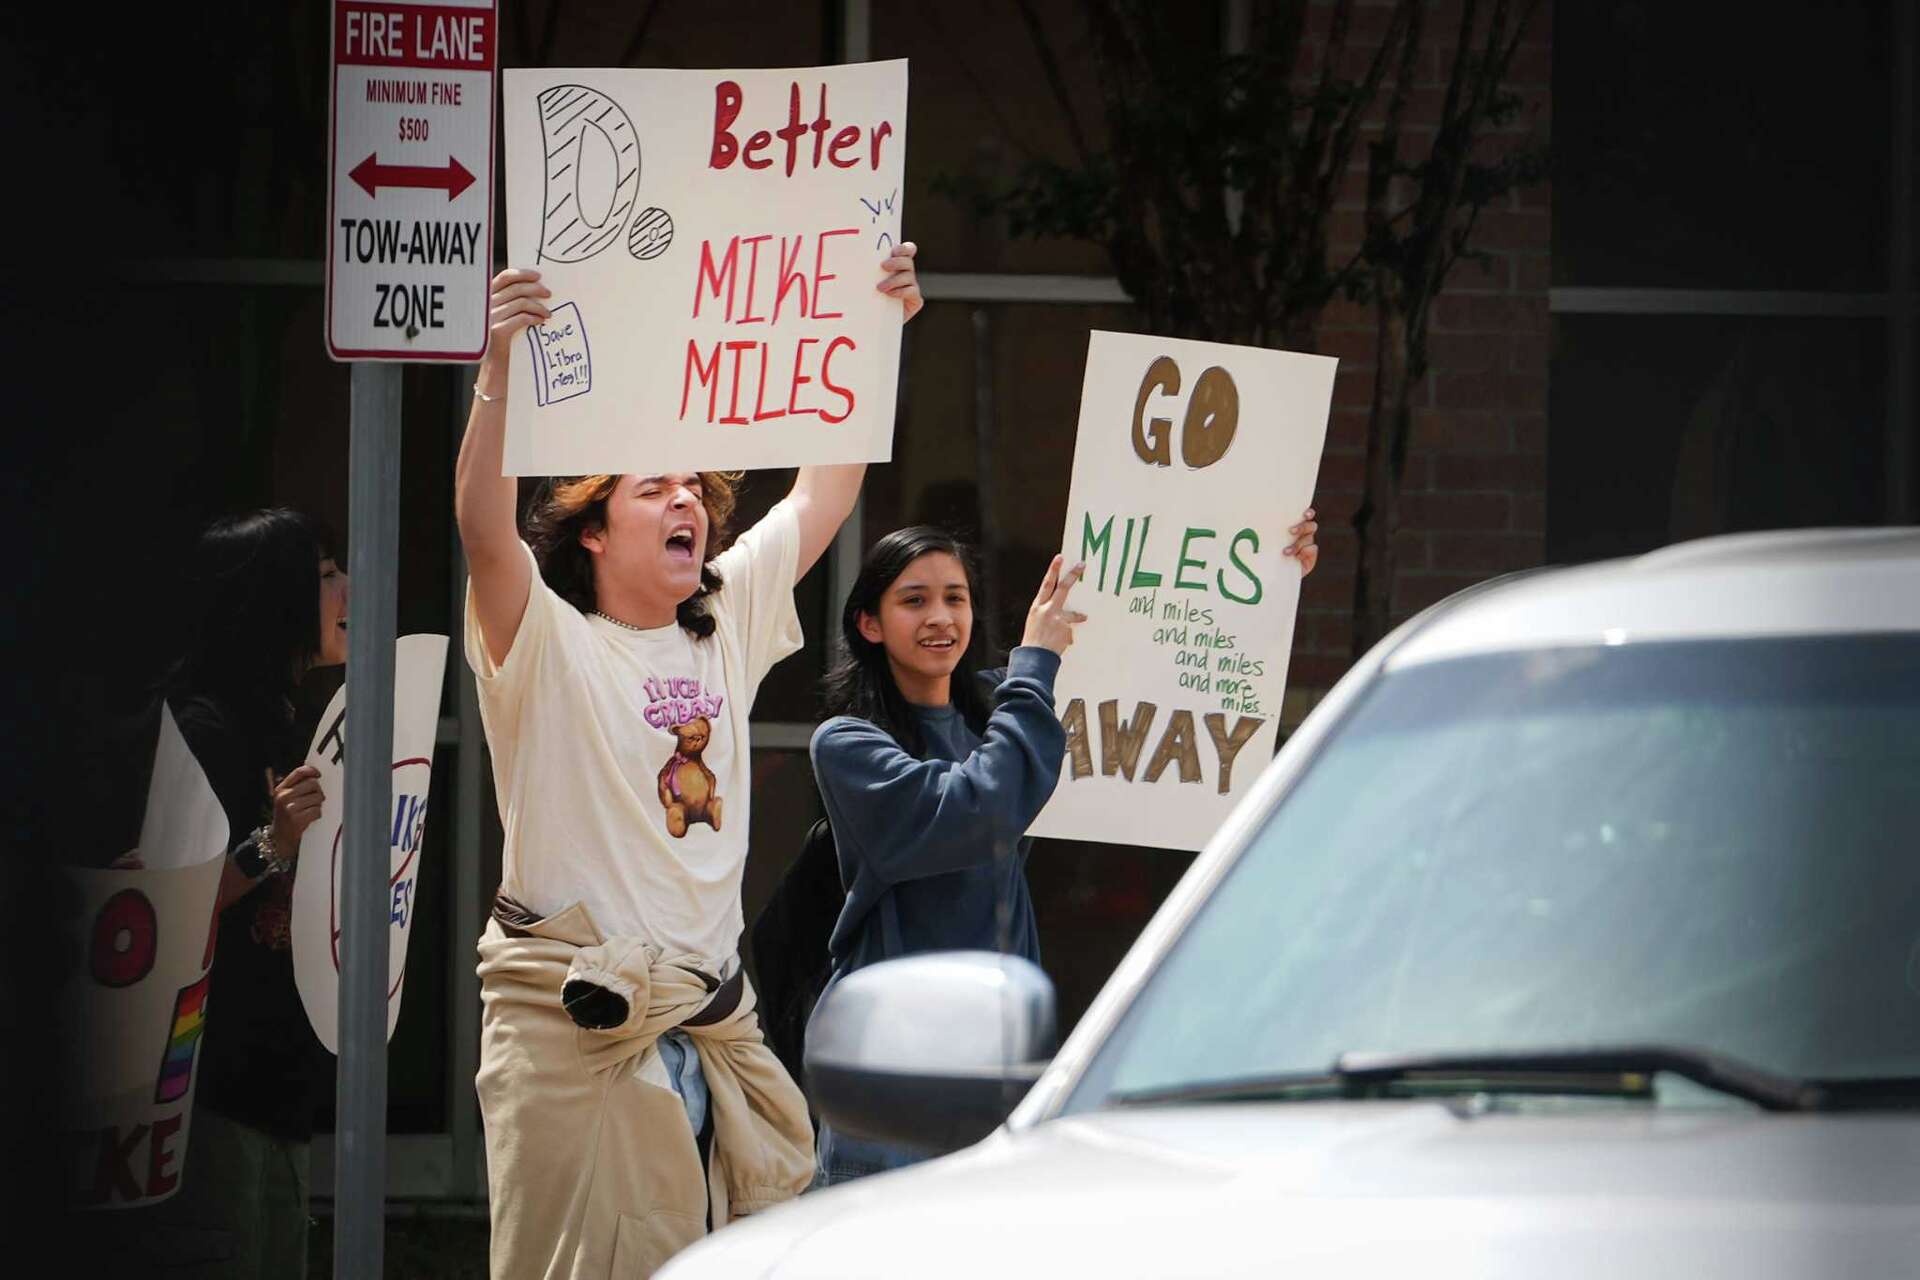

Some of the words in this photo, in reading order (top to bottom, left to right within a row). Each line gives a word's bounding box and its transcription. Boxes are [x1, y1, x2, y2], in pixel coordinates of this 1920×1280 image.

[345, 11, 404, 58] FIRE
[416, 14, 485, 62] LANE
[366, 79, 427, 105] MINIMUM
[432, 83, 462, 106] FINE
[398, 117, 429, 143] $500
[709, 81, 892, 177] Better
[340, 219, 481, 265] TOW-AWAY
[693, 229, 860, 326] MIKE
[373, 284, 445, 329] ZONE
[540, 323, 574, 346] Save
[680, 336, 856, 426] MILES
[1131, 354, 1240, 470] GO
[1078, 510, 1263, 605] MILES
[1129, 589, 1156, 619] and
[1163, 599, 1214, 626] miles
[1153, 626, 1187, 646] and
[1194, 627, 1238, 650] miles
[1175, 649, 1208, 669] and
[1218, 652, 1264, 677] miles
[1179, 672, 1210, 693] and
[1216, 678, 1256, 700] more
[1060, 697, 1266, 795] AWAY
[391, 794, 427, 852] IKE
